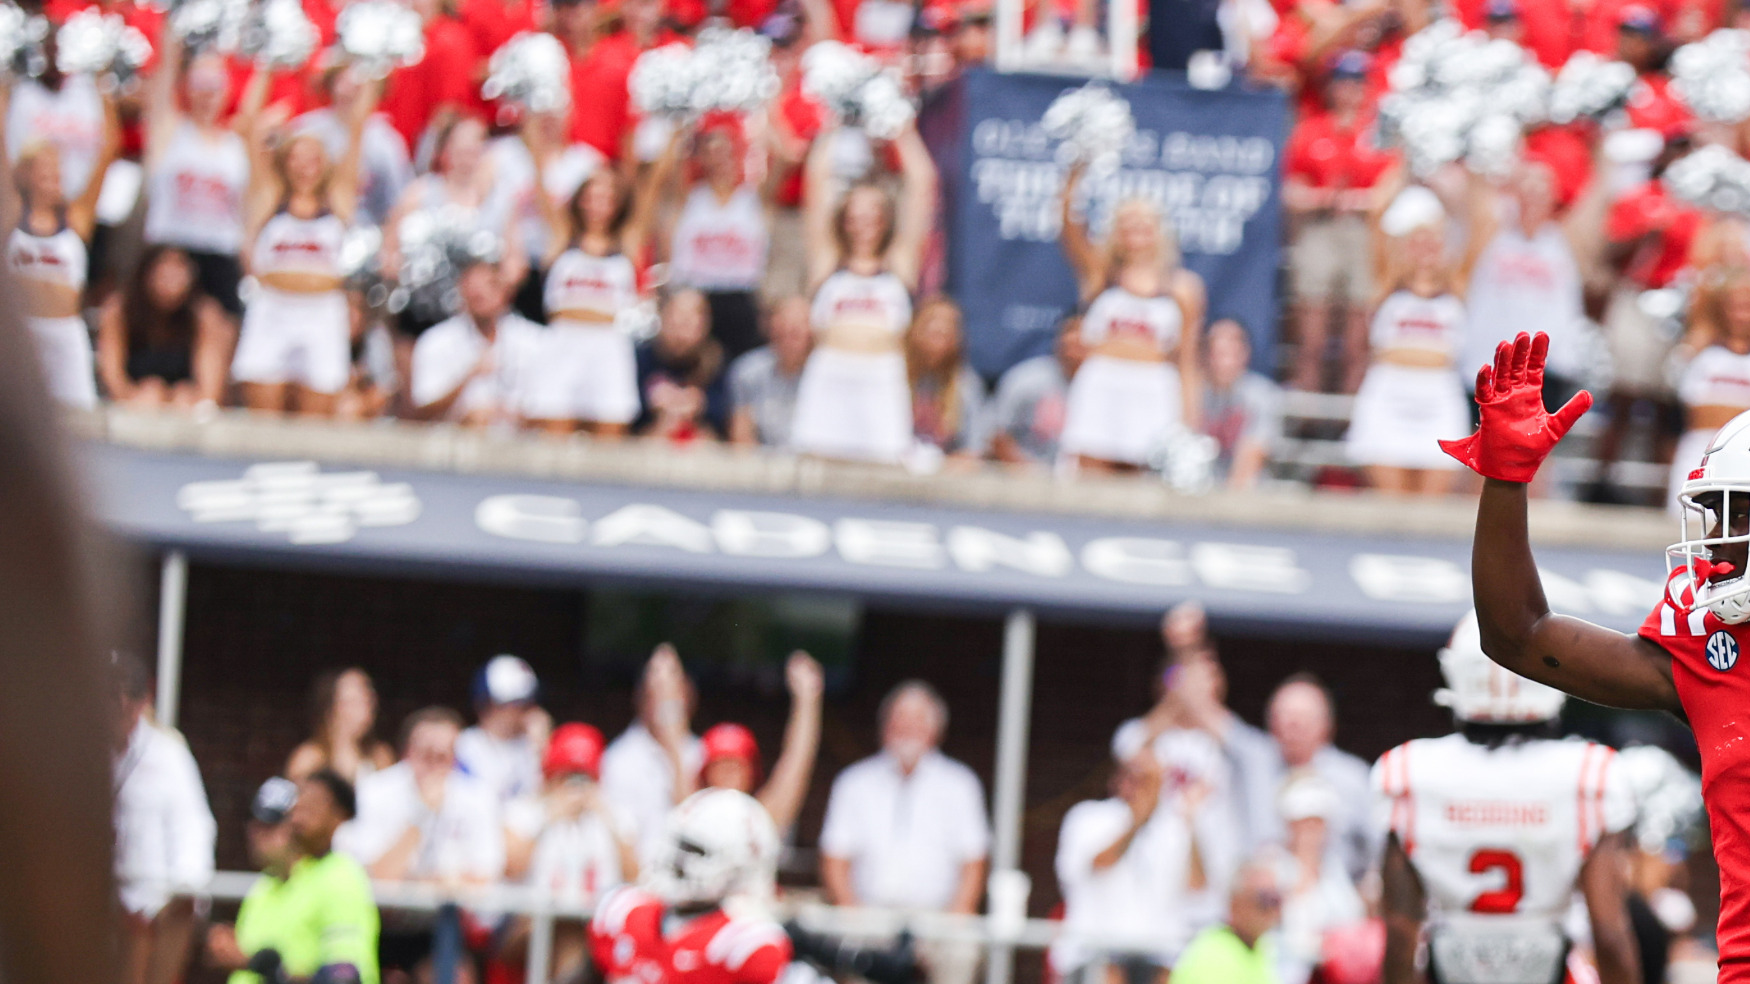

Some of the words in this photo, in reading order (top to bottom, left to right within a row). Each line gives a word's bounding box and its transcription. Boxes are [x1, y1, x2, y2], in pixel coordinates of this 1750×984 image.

[474, 494, 1310, 595] CADENCE
[1706, 631, 1737, 670] SEC
[1467, 846, 1526, 914] 2
